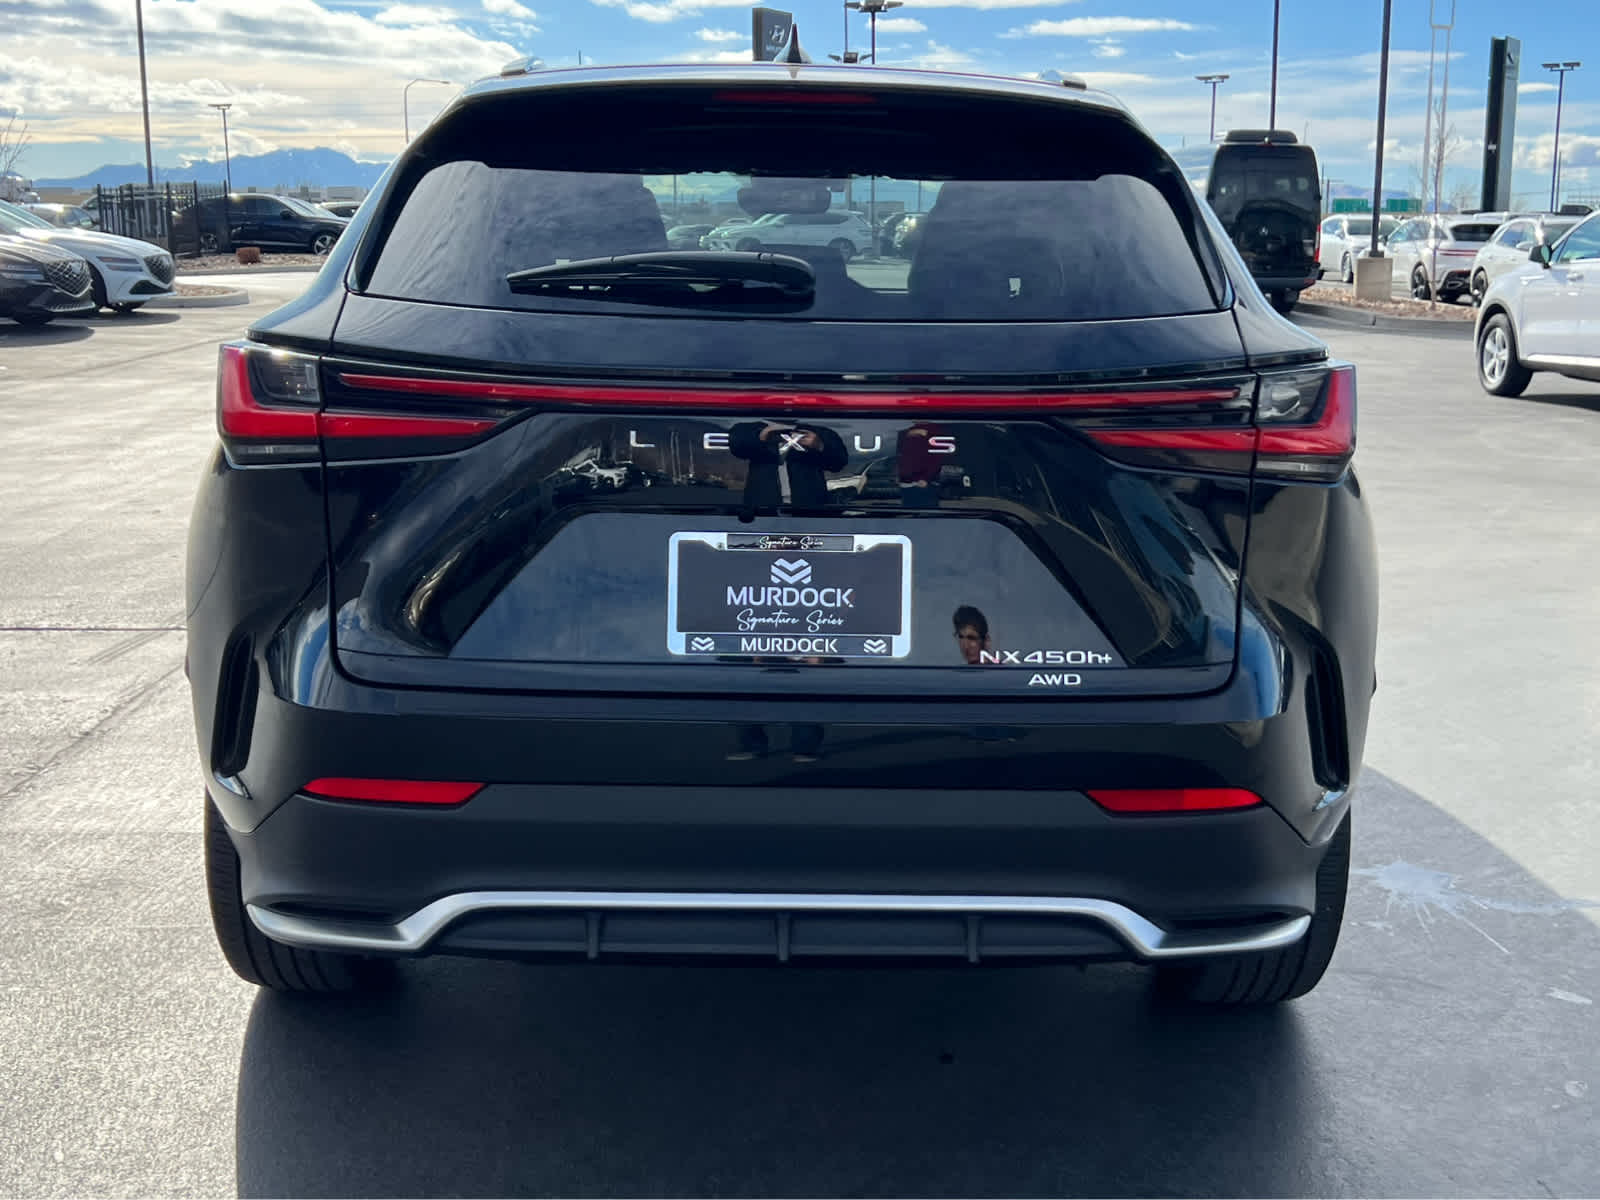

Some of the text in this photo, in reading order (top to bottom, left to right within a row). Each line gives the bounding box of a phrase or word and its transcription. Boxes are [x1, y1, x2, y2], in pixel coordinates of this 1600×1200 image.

[629, 430, 956, 453] LEXUS
[726, 585, 854, 608] MURDOCK
[736, 608, 844, 632] Signature Series
[740, 637, 838, 653] MURDOCK
[979, 650, 1113, 664] NX450h+
[1027, 673, 1081, 686] AWD
